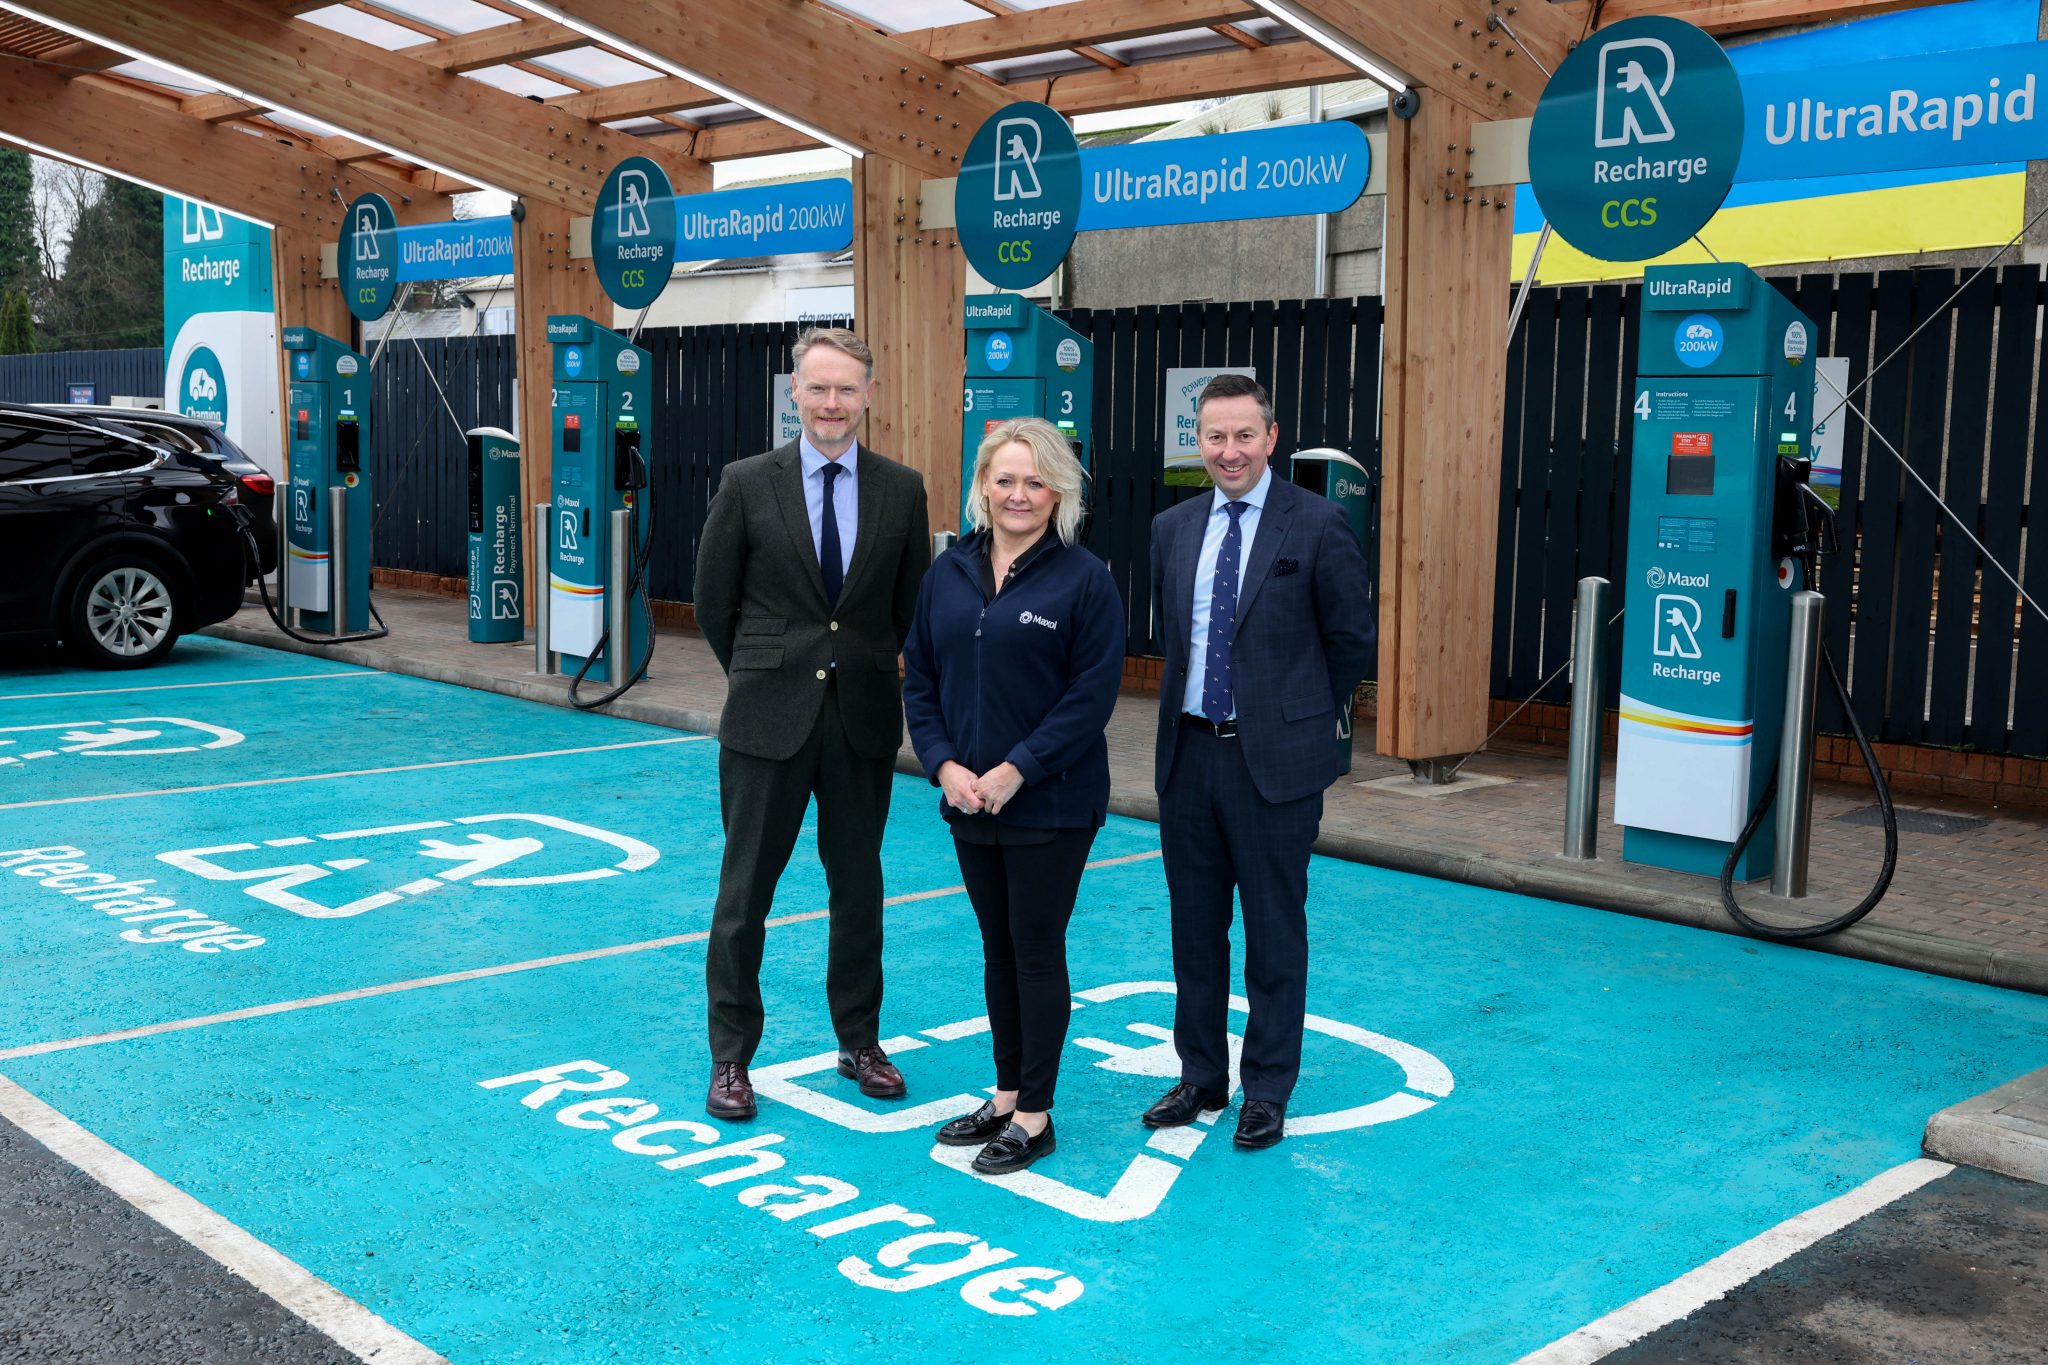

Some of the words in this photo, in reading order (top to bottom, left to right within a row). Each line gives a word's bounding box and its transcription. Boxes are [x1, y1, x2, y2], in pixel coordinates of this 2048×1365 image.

[1765, 74, 2035, 145] UltraRapid
[1094, 156, 1247, 204] UltraRapid
[1256, 153, 1348, 190] 200kW
[1594, 156, 1708, 183] Recharge
[684, 203, 782, 241] UltraRapid
[788, 203, 846, 230] 200kW
[993, 208, 1061, 231] Recharge
[1601, 197, 1657, 228] CCS
[403, 235, 474, 266] UltraRapid
[477, 235, 513, 258] 200kW
[618, 243, 663, 262] Recharge
[998, 240, 1032, 264] CCS
[182, 254, 240, 286] Recharge
[356, 266, 389, 282] Recharge
[621, 269, 645, 288] CCS
[359, 288, 376, 304] CCS
[1649, 278, 1731, 298] UltraRapid
[966, 304, 1012, 319] UltraRapid
[548, 324, 578, 335] UltraRapid
[988, 351, 1009, 360] 200kW
[1680, 341, 1718, 352] 200kW
[343, 389, 352, 405] 1
[1181, 375, 1213, 397] Powere
[622, 391, 633, 410] 2
[1061, 390, 1073, 414] 3
[1634, 390, 1652, 421] 4
[1784, 391, 1796, 422] 4
[565, 499, 580, 508] Maxol
[296, 523, 312, 535] Recharge
[493, 505, 507, 575] Recharge
[509, 534, 517, 574] Payment
[560, 551, 585, 566] Recharge
[1668, 571, 1709, 588] Maxol
[1032, 614, 1057, 630] Maxol
[1653, 662, 1721, 686] Recharge
[0, 845, 266, 953] Recharge
[479, 1059, 1085, 1316] Recharge
